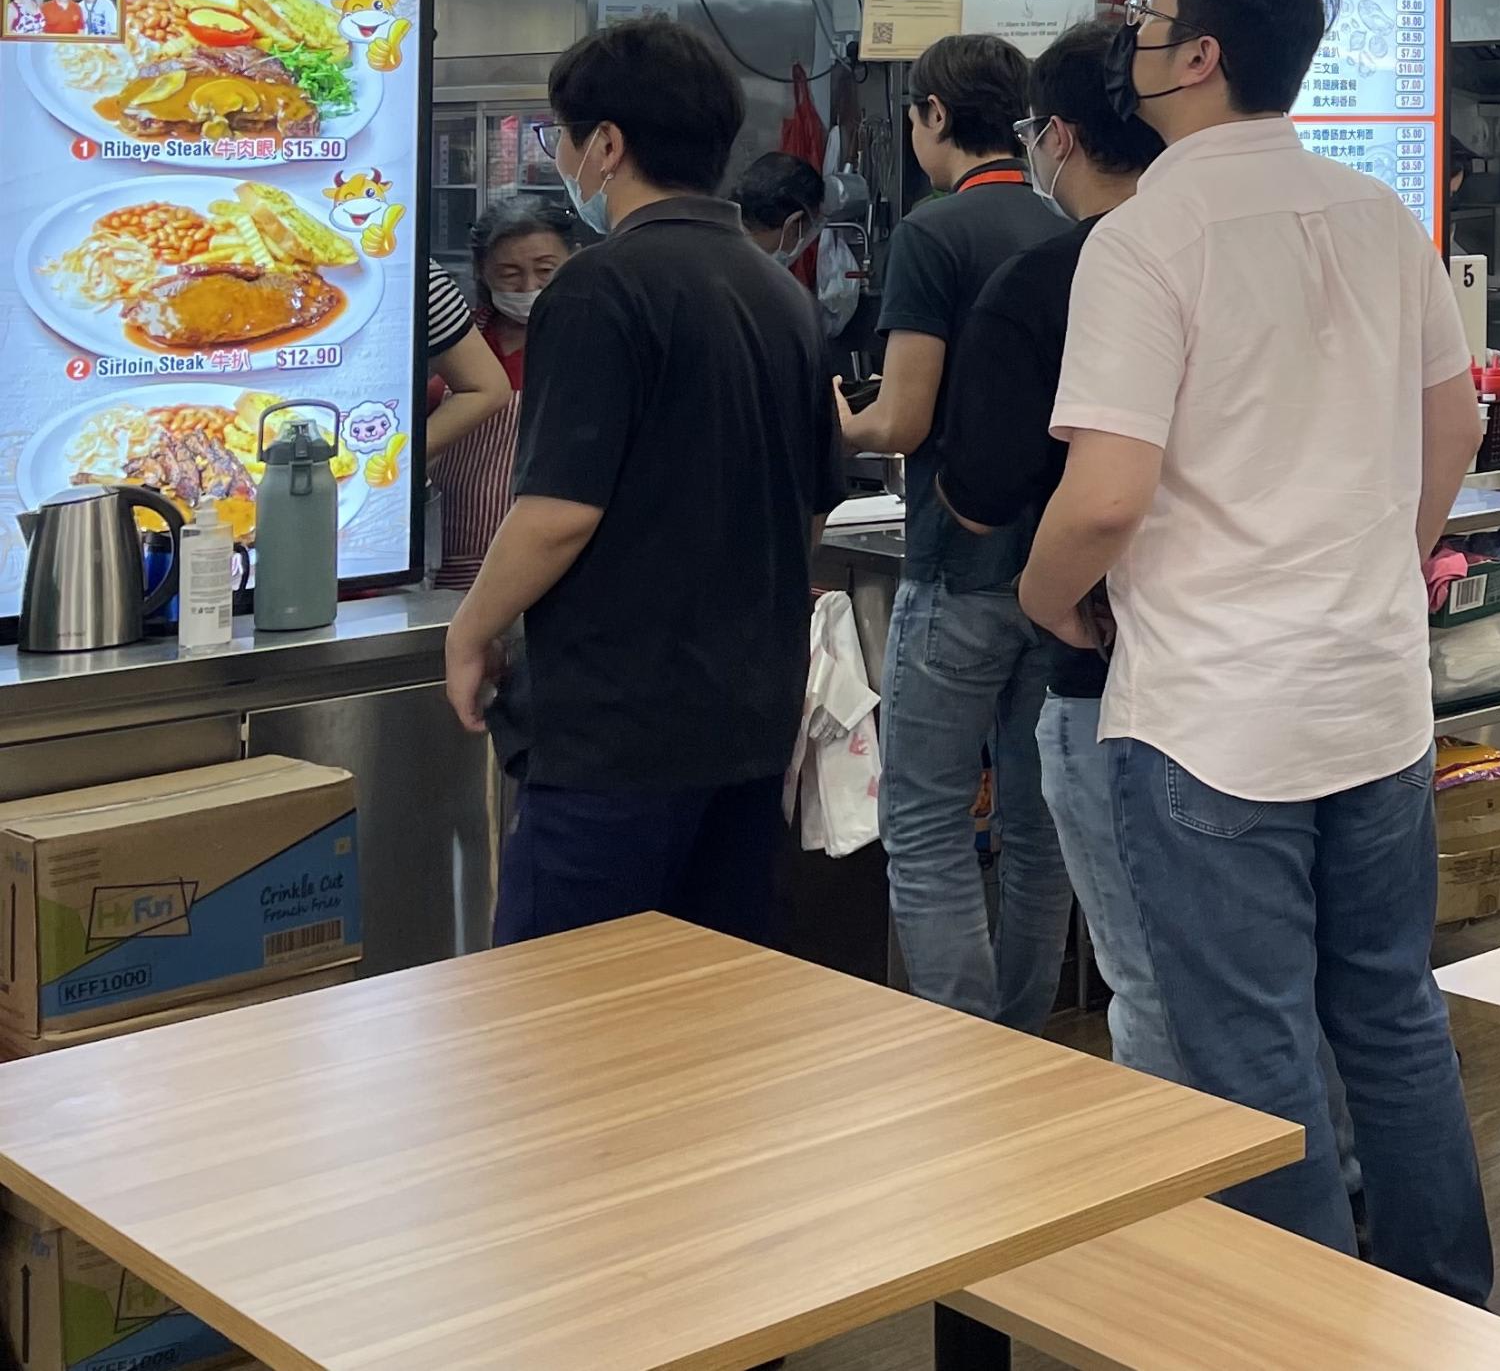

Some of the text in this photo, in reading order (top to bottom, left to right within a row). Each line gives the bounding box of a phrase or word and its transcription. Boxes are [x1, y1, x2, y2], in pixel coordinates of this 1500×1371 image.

[80, 141, 211, 160] 1 Ribeye Steak
[215, 140, 341, 158] 牛肉眼 $15.90
[1464, 263, 1474, 288] 5
[74, 355, 205, 377] 2 Sirloin Steak
[211, 347, 337, 370] 牛扒 $12.90
[260, 871, 345, 906] Crinkle Cut
[263, 896, 342, 924] French Fries
[64, 969, 147, 1001] KFF1000
